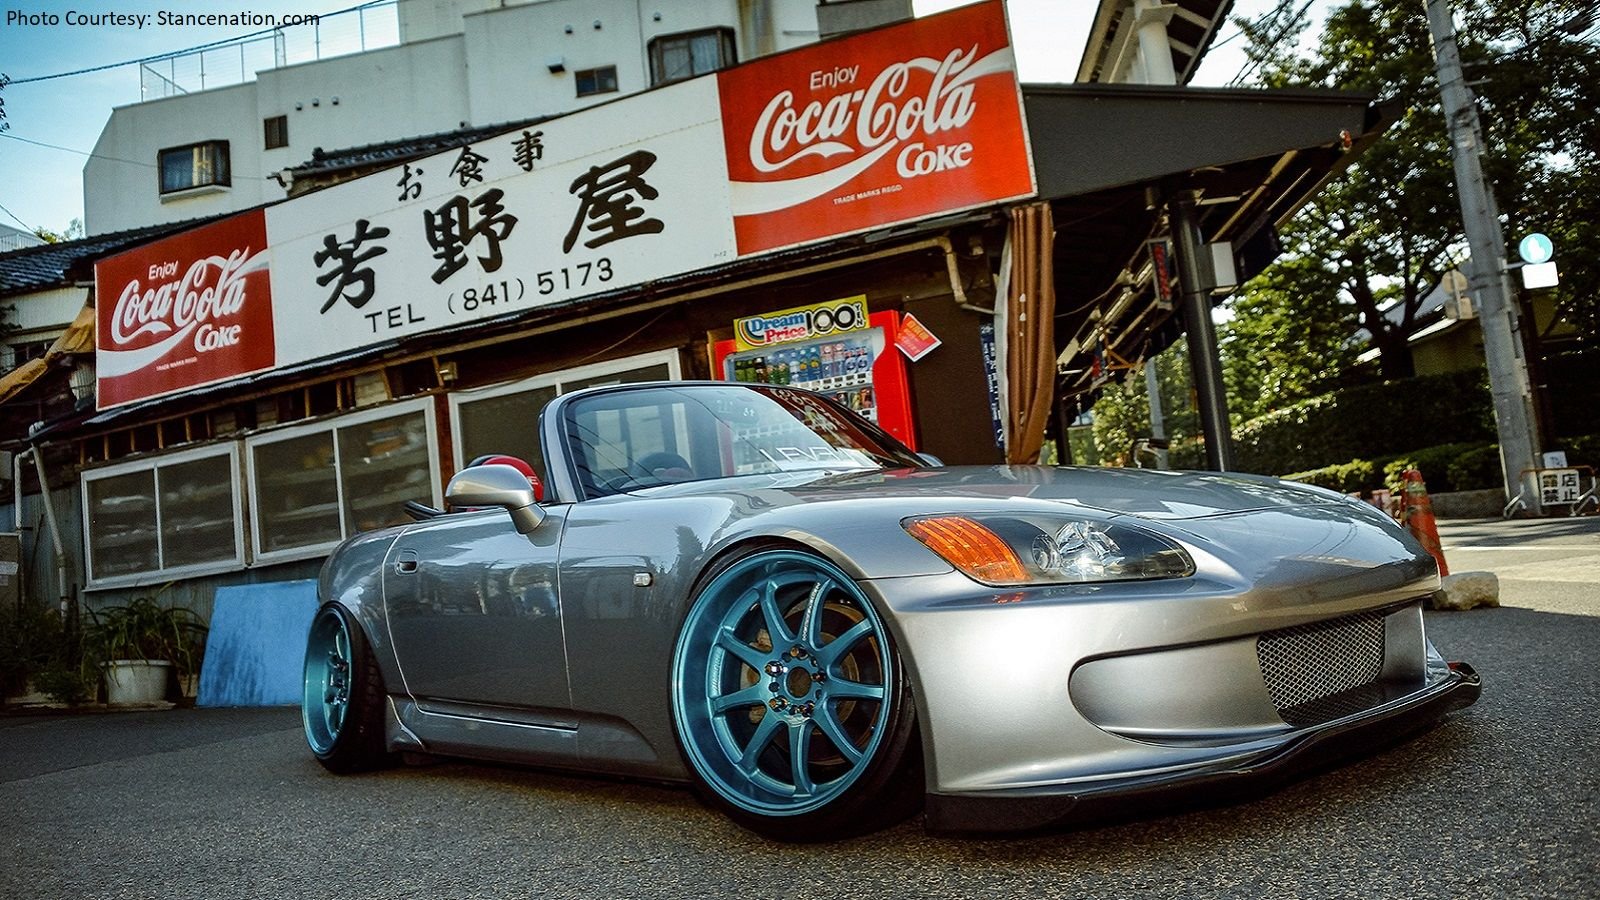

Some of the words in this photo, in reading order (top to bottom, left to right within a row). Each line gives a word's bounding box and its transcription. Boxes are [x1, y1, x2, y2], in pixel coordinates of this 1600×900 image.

[809, 64, 860, 91] Enjoy
[749, 43, 979, 173] Coca-Cola
[397, 130, 544, 201] お食事
[896, 142, 974, 179] Coke
[313, 149, 665, 315] 芳野屋
[148, 260, 179, 281] Enjoy
[111, 246, 250, 345] Coca-Cola
[364, 303, 426, 333] TEL
[447, 277, 525, 315] (841)
[537, 257, 615, 296] 5173
[750, 313, 805, 333] Dream
[764, 326, 806, 343] Price
[805, 304, 856, 334] 100
[194, 324, 242, 353] Coke
